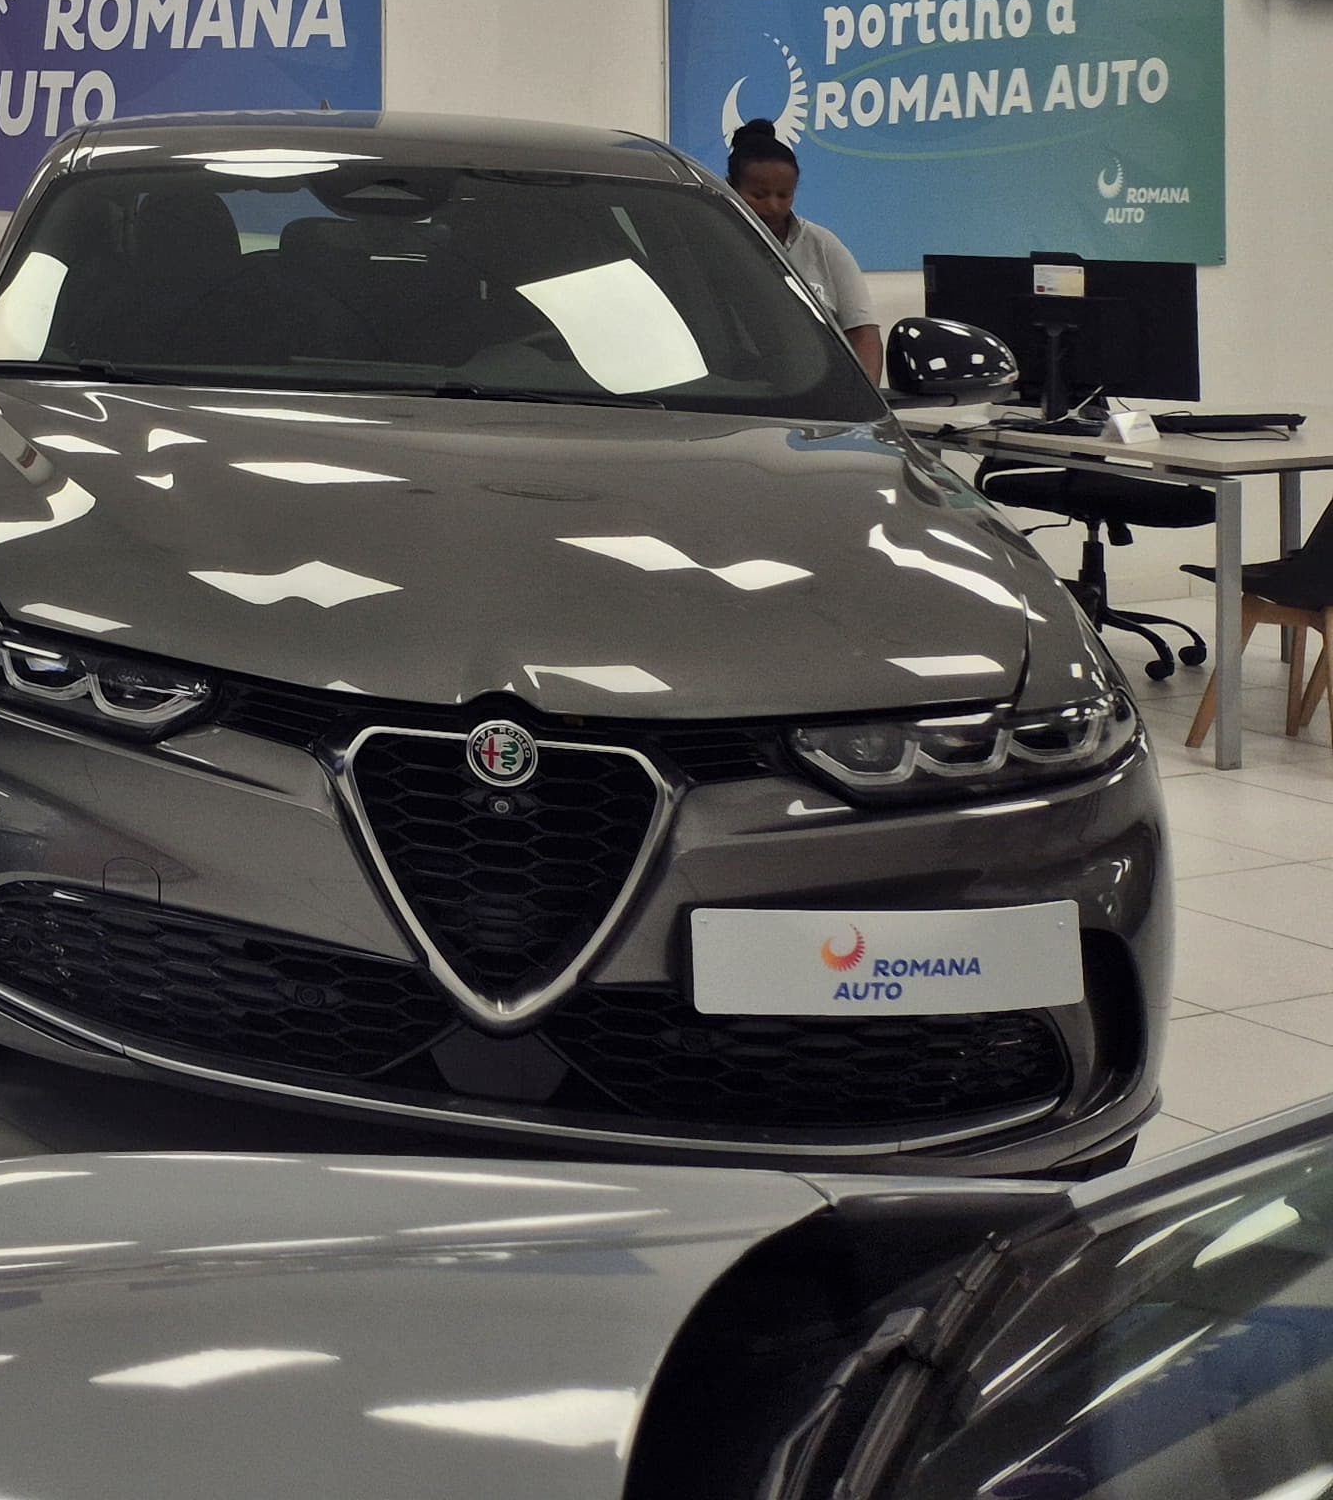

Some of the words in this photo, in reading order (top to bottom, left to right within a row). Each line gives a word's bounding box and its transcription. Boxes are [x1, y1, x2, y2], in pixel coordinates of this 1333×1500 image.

[813, 67, 1033, 131] ROMANA
[1042, 57, 1169, 112] AUTO
[1125, 187, 1190, 204] ROMANA
[1103, 207, 1145, 224] AUTO
[499, 726, 532, 759] ROMEO
[871, 957, 982, 979] ROMANA
[832, 981, 903, 1002] AUTO
